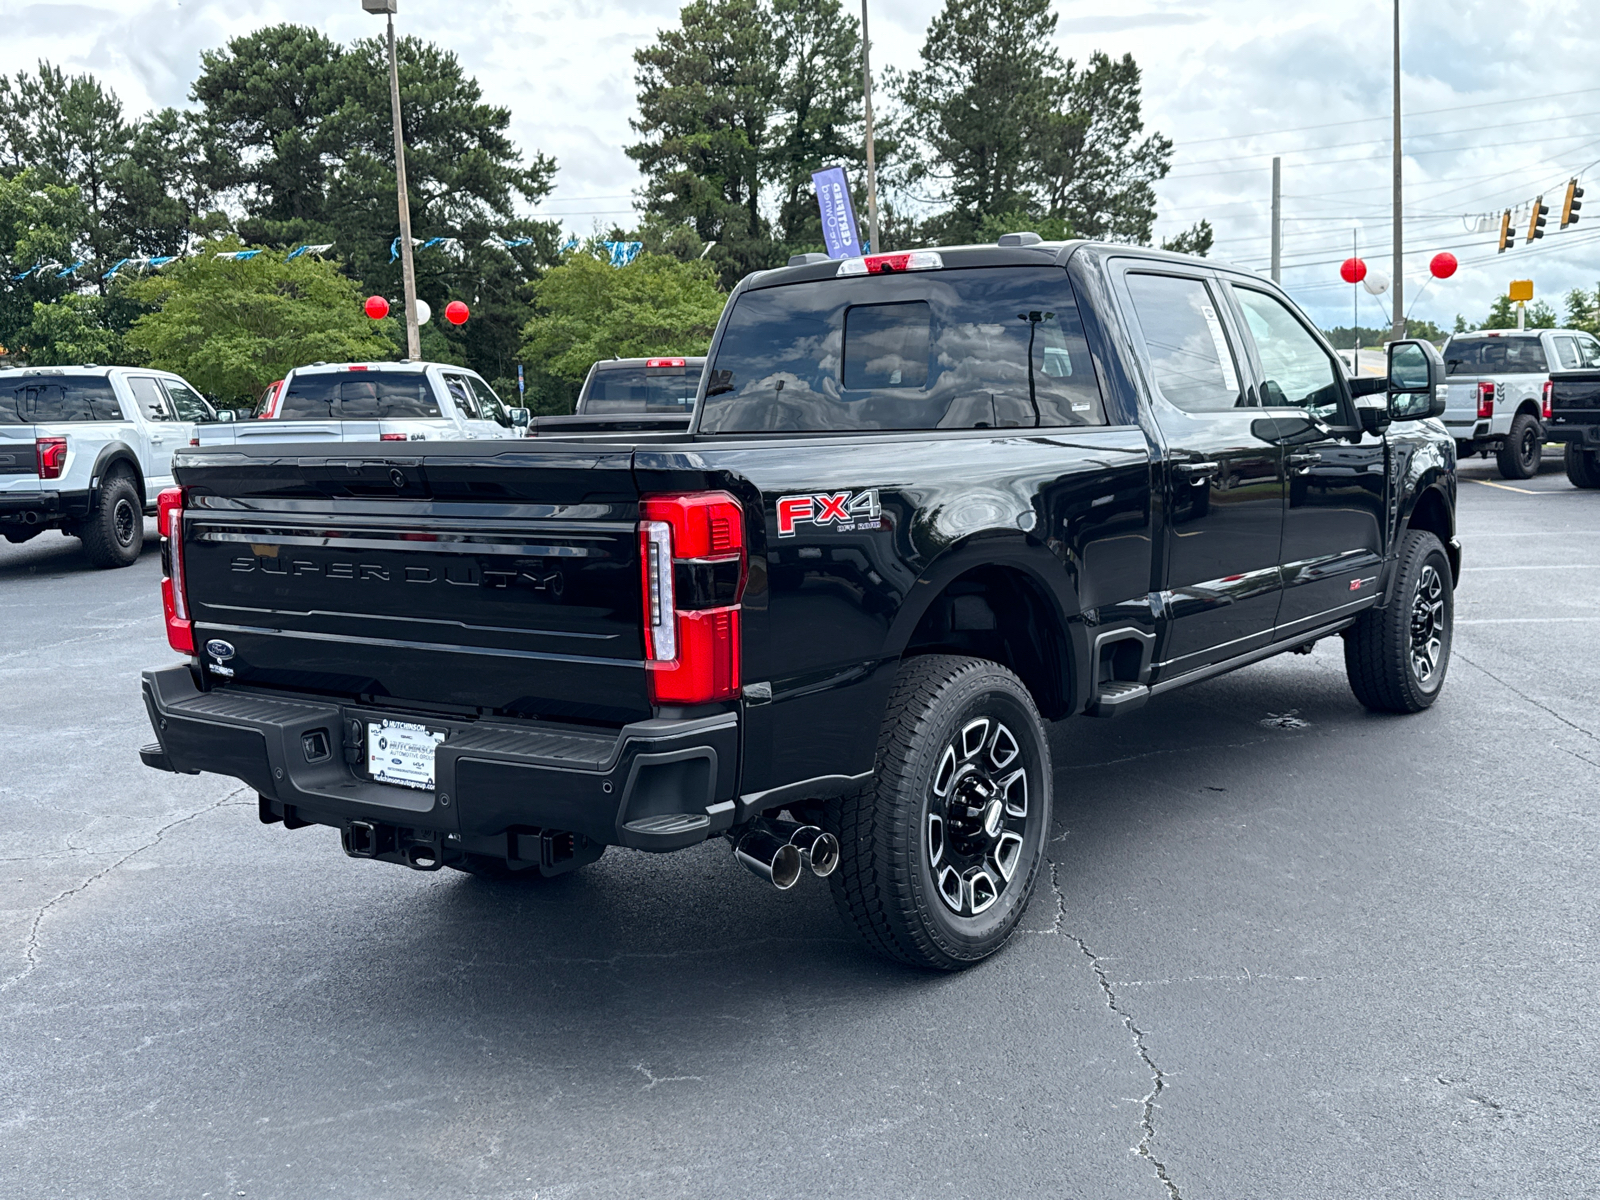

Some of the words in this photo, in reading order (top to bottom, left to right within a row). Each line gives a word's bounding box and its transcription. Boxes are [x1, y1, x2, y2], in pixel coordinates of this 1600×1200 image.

[776, 489, 881, 538] FX4
[231, 557, 390, 581] SUPER
[404, 566, 558, 589] DUTY
[389, 721, 426, 732] HUTCHINSON
